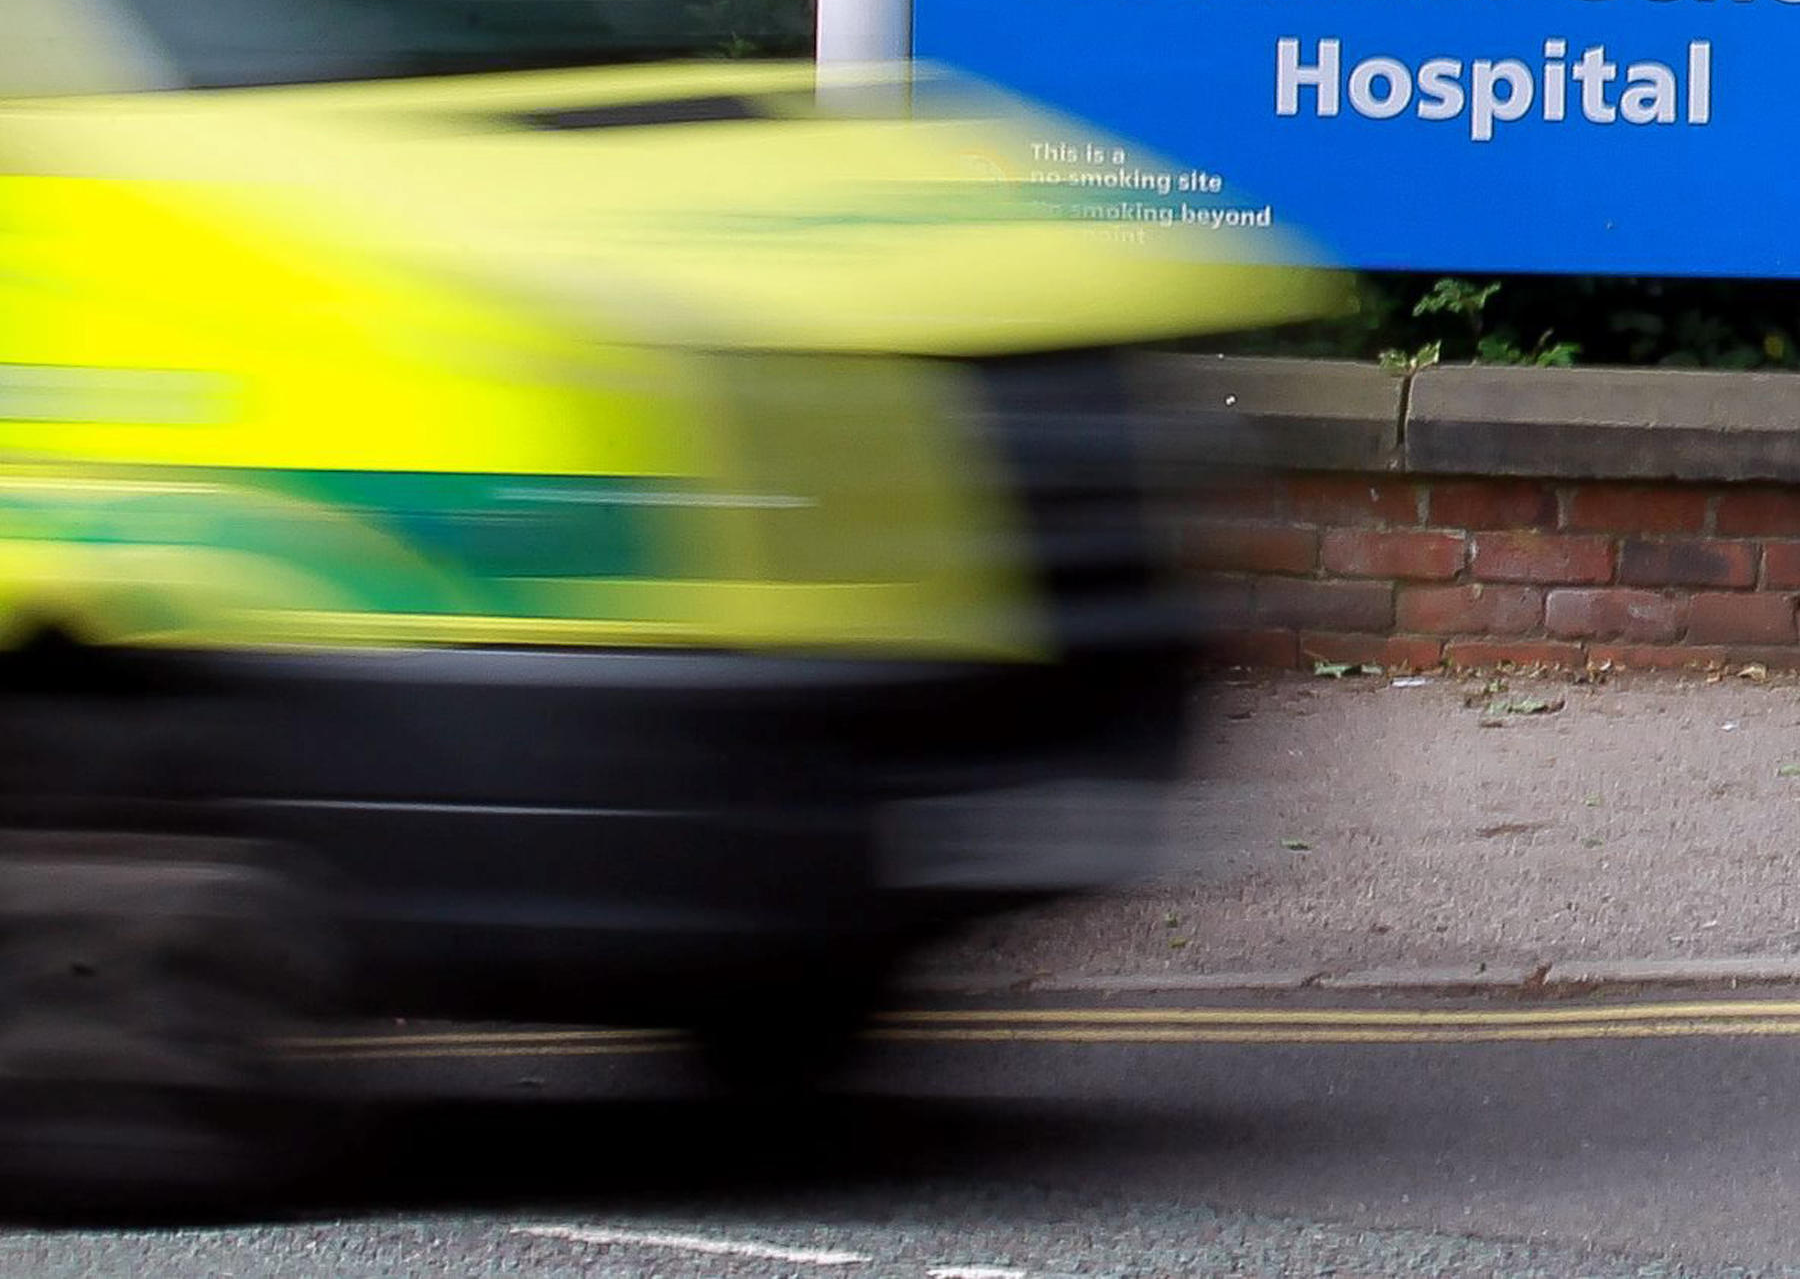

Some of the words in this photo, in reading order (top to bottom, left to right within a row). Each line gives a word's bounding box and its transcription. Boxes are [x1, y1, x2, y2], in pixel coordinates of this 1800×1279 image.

[1276, 38, 1711, 141] Hospital
[1030, 142, 1077, 163] This
[1086, 142, 1104, 164] is
[1112, 148, 1125, 165] a
[1069, 169, 1170, 195] smoking
[1178, 169, 1223, 192] site
[1181, 201, 1271, 229] beyond
